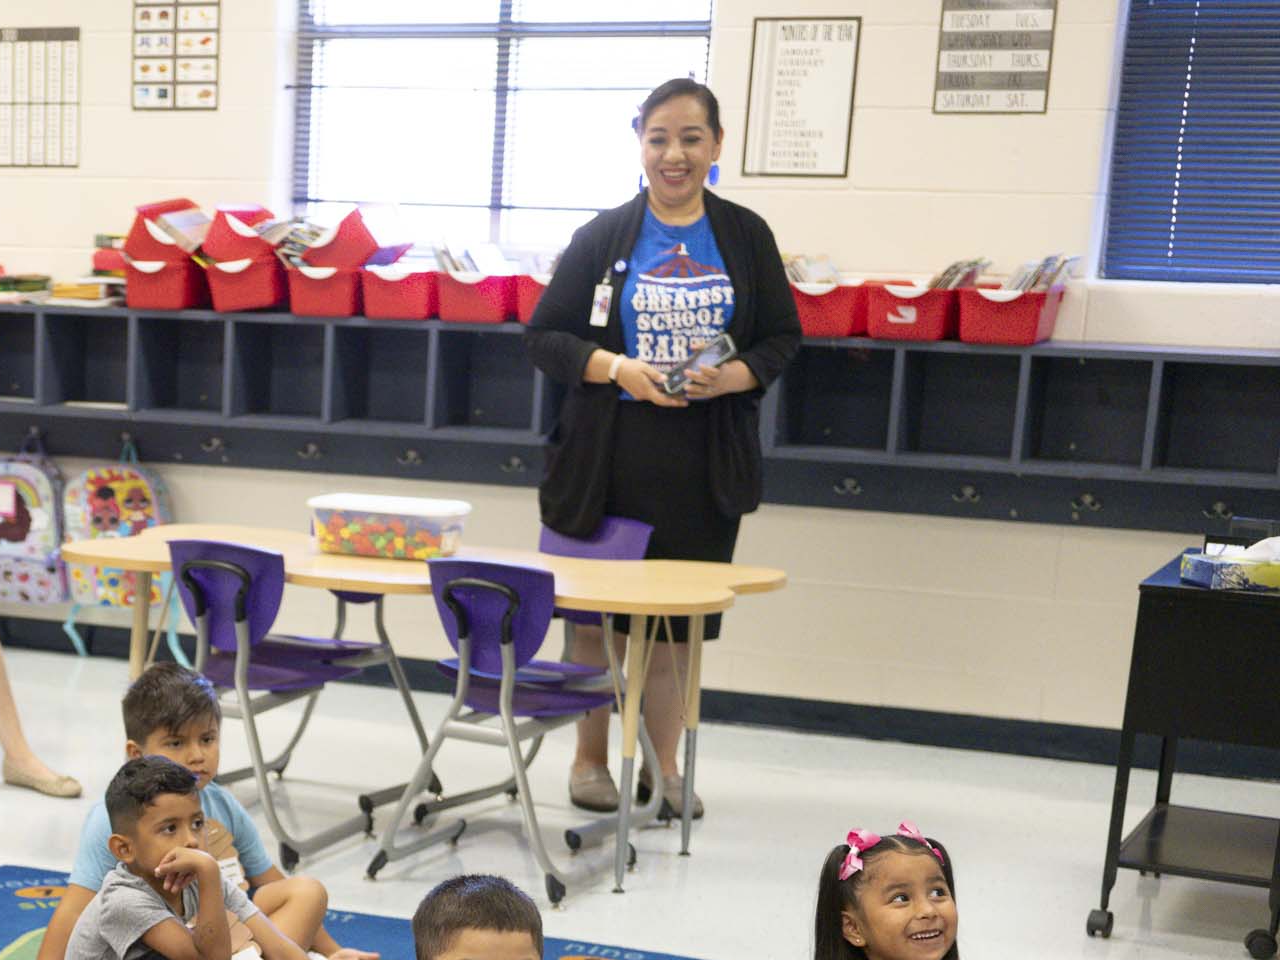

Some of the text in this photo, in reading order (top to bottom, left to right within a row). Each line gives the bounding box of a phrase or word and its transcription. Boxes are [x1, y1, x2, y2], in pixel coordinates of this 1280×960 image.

[951, 14, 991, 28] TUESDAY
[823, 24, 833, 41] THE
[837, 24, 855, 41] YEAR
[947, 54, 992, 68] THURSDAY
[942, 94, 991, 108] SATURDAY
[631, 285, 735, 312] GREATEST
[636, 307, 725, 331] SCHOOL
[636, 333, 704, 362] EAR
[17, 898, 61, 911] sie
